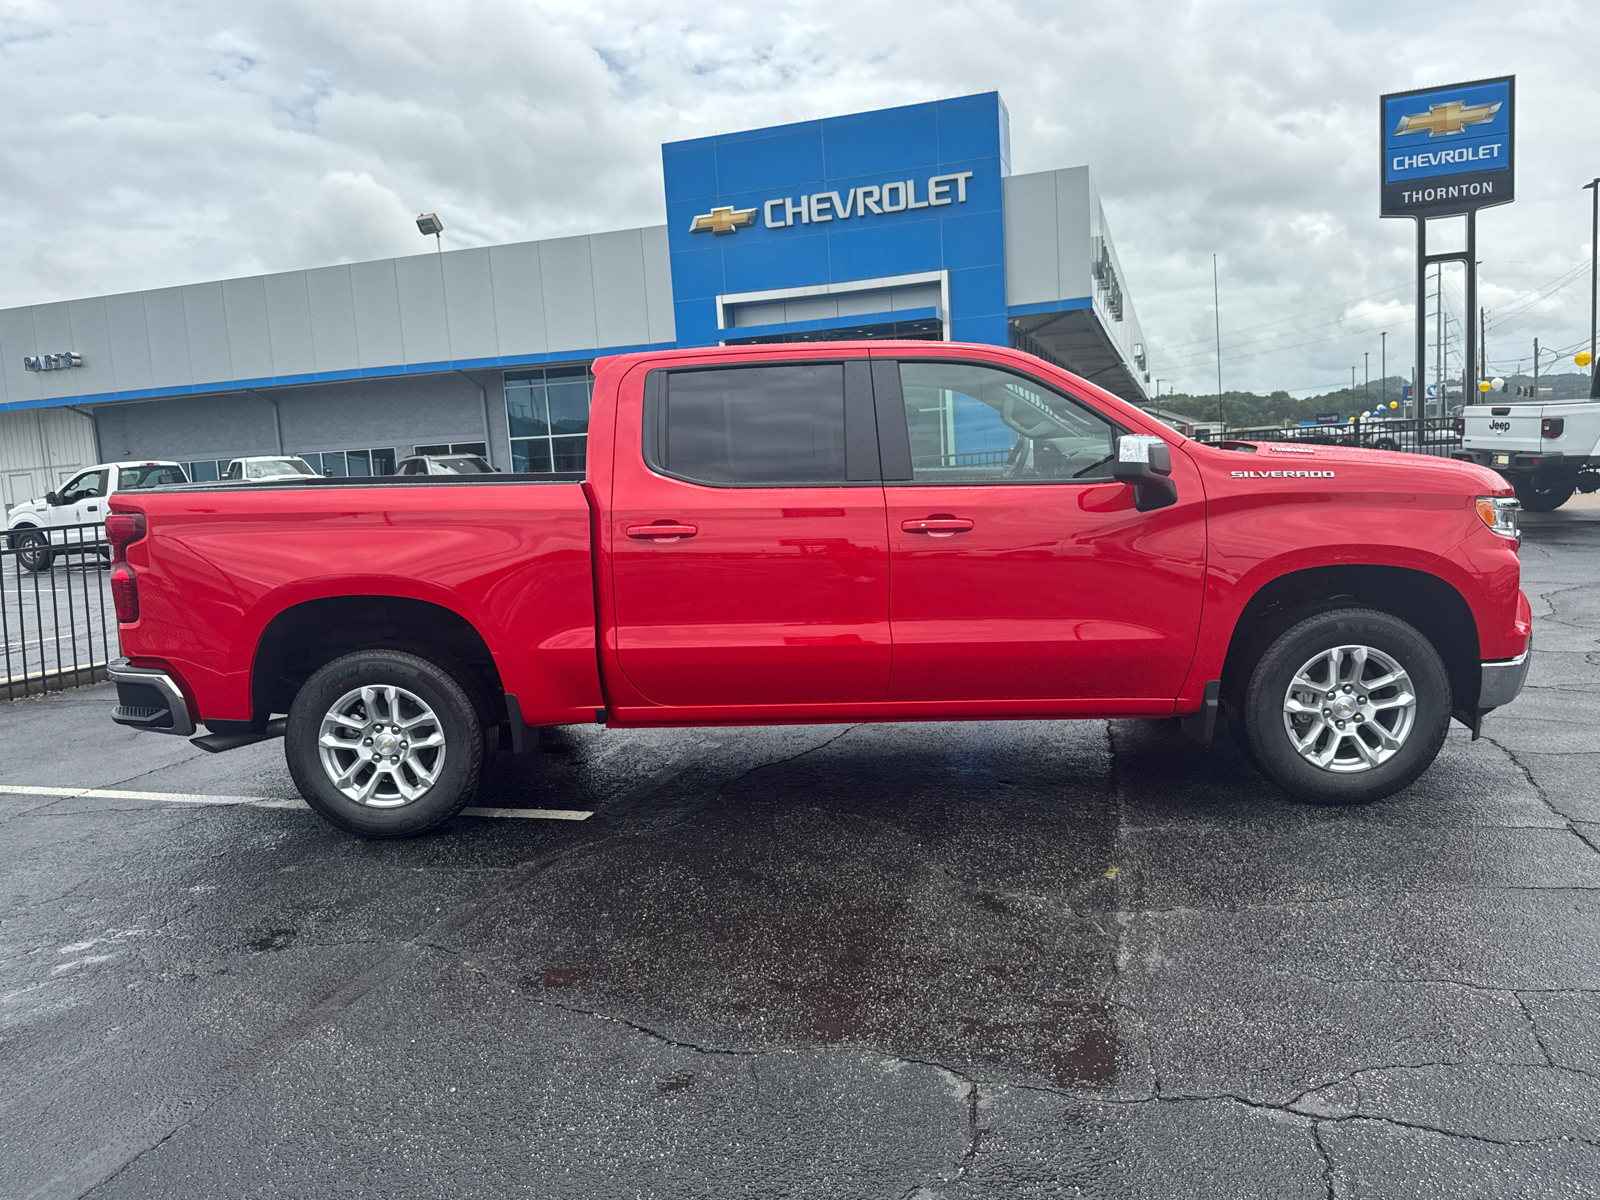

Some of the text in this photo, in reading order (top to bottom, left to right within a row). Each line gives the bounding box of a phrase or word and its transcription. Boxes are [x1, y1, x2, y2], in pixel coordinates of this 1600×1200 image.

[1393, 143, 1501, 171] CHEVROLET
[764, 171, 973, 229] CHEVROLET
[1402, 181, 1493, 203] THORNTON
[24, 351, 76, 371] PARTS
[1489, 419, 1510, 432] Jeep
[1230, 470, 1335, 479] SILVERADO
